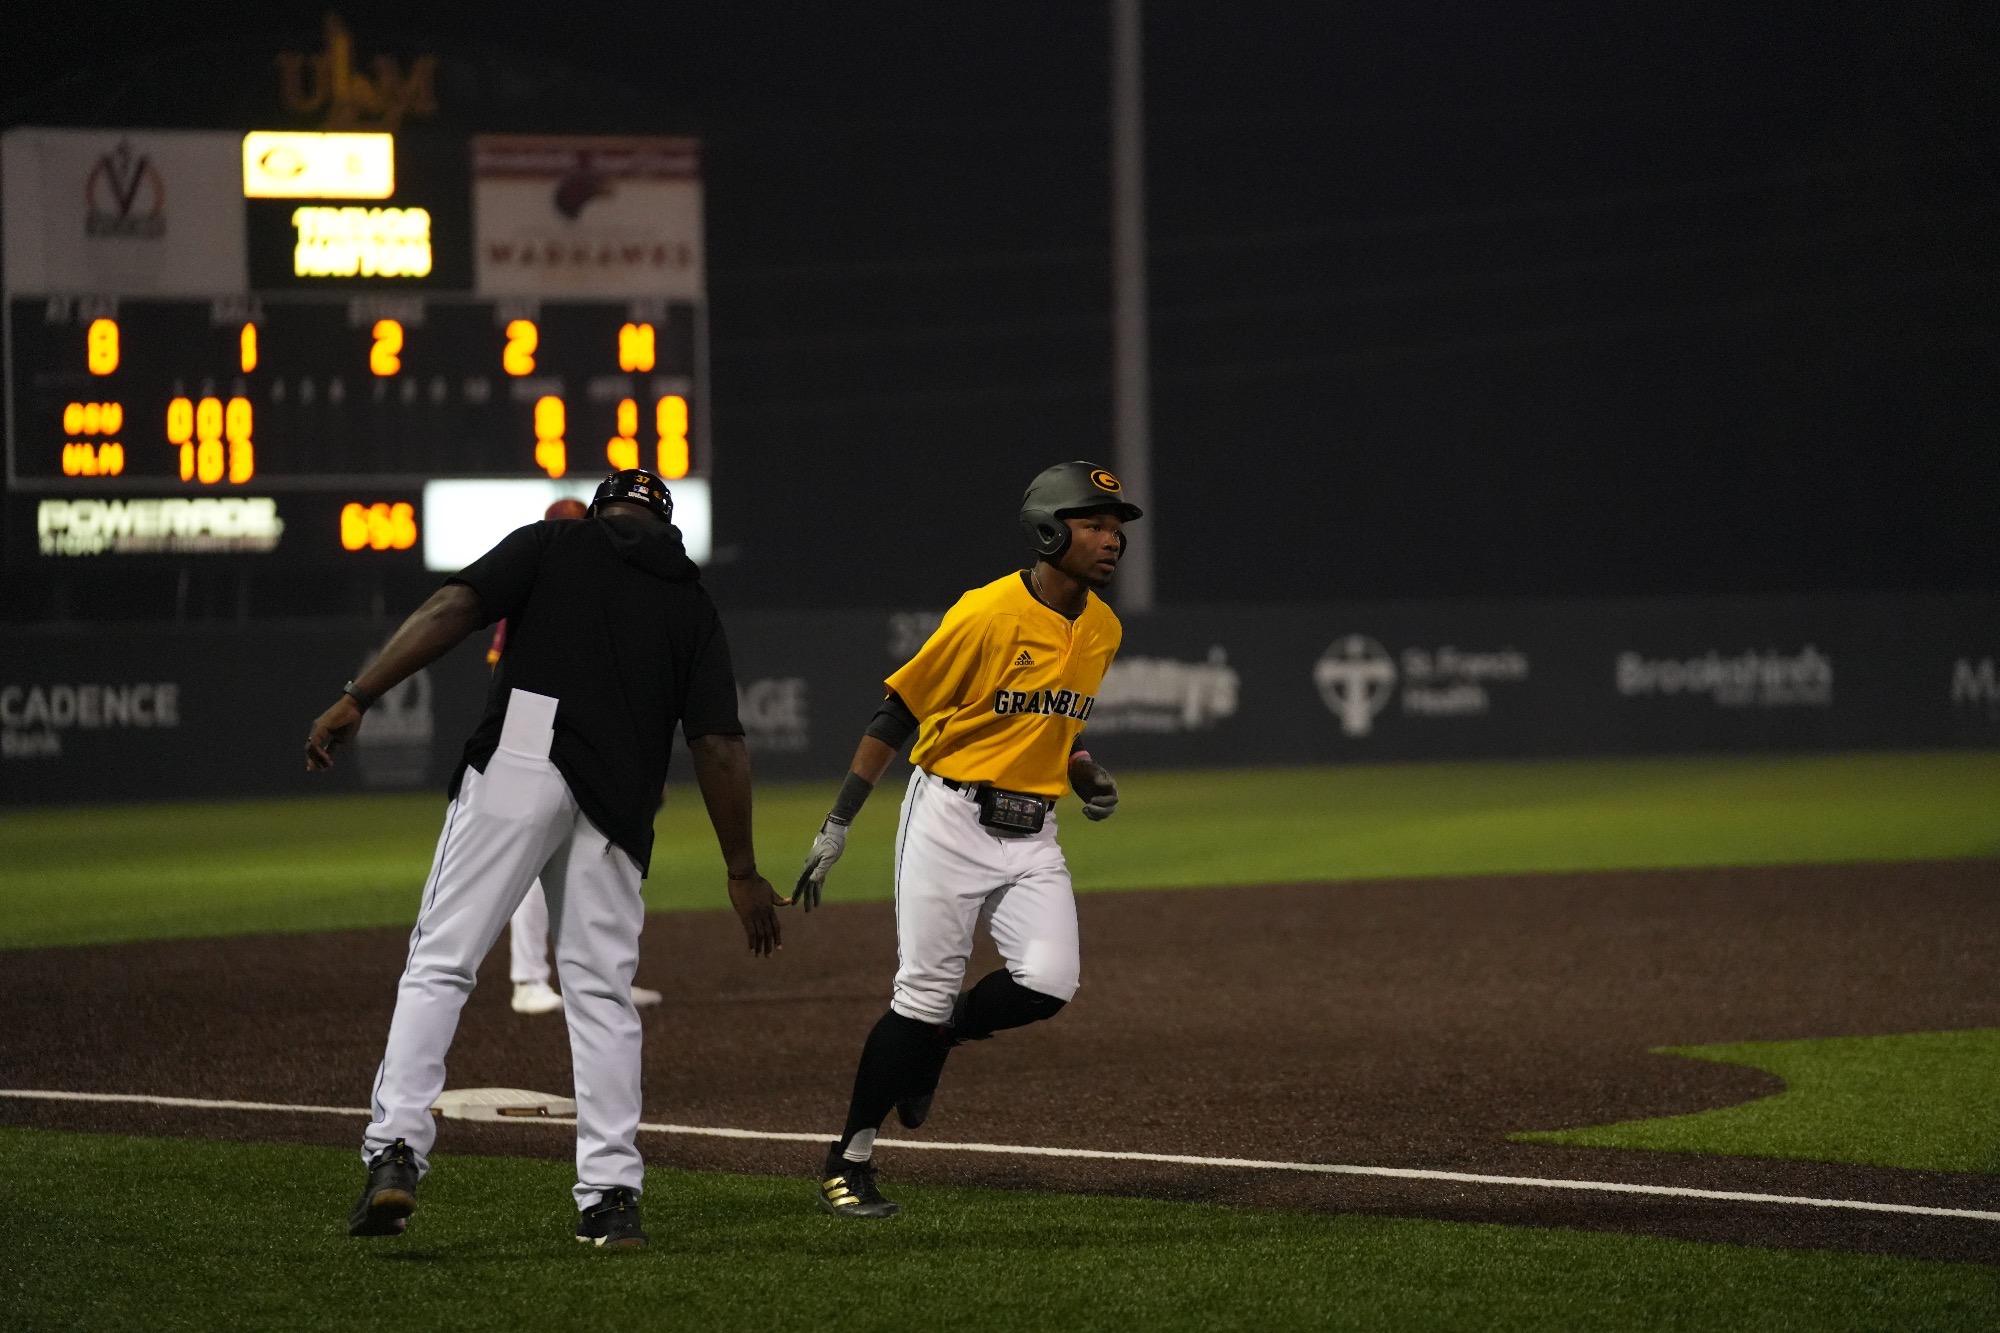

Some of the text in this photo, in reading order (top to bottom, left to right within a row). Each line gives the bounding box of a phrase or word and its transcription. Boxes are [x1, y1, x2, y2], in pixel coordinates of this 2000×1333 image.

[369, 319, 404, 376] 2
[502, 319, 539, 376] 2
[636, 474, 651, 484] 37
[0, 683, 179, 728] CADENCE
